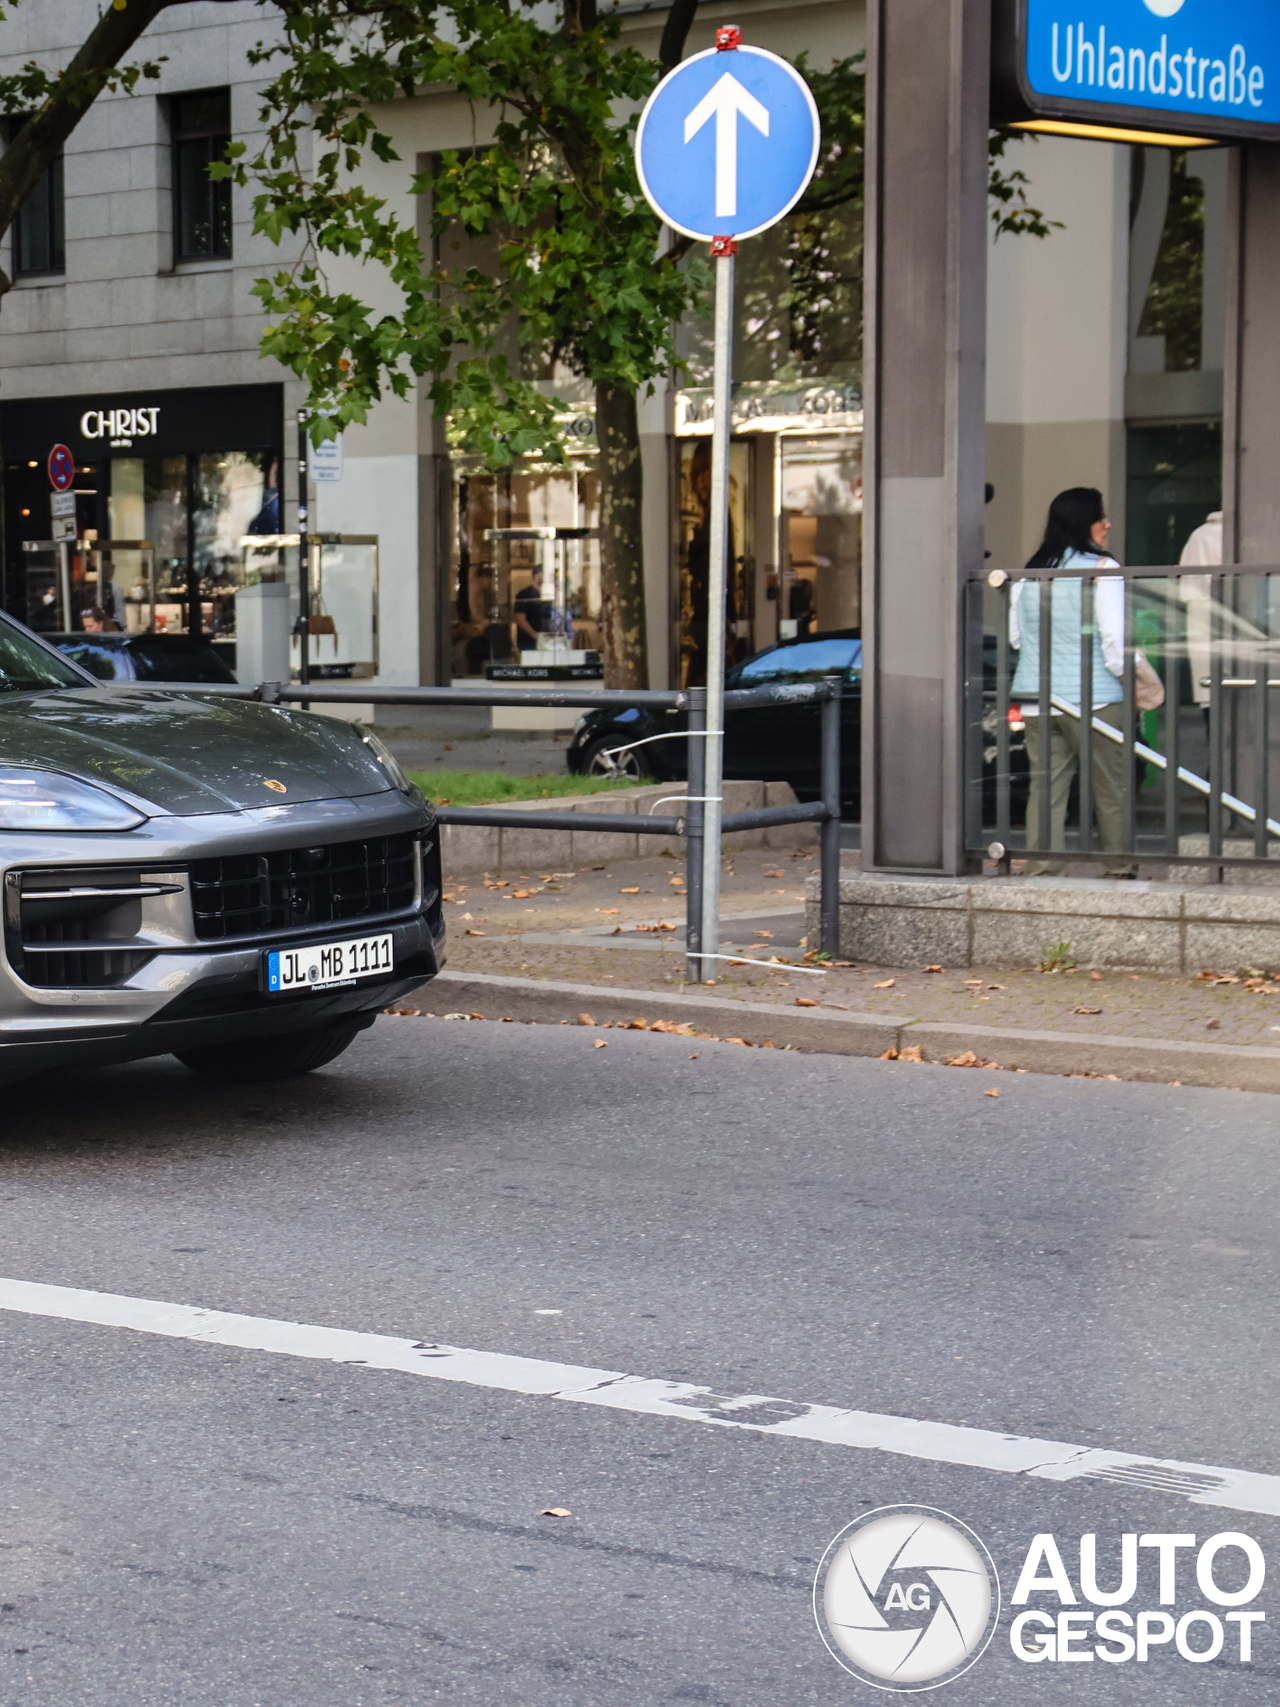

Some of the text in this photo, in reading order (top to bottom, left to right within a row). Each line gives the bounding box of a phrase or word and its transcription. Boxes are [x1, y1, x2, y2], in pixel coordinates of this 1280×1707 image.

[1052, 22, 1265, 107] Uhlandstraße
[80, 407, 161, 439] CHRIST
[271, 939, 391, 985] D JL MB 1111
